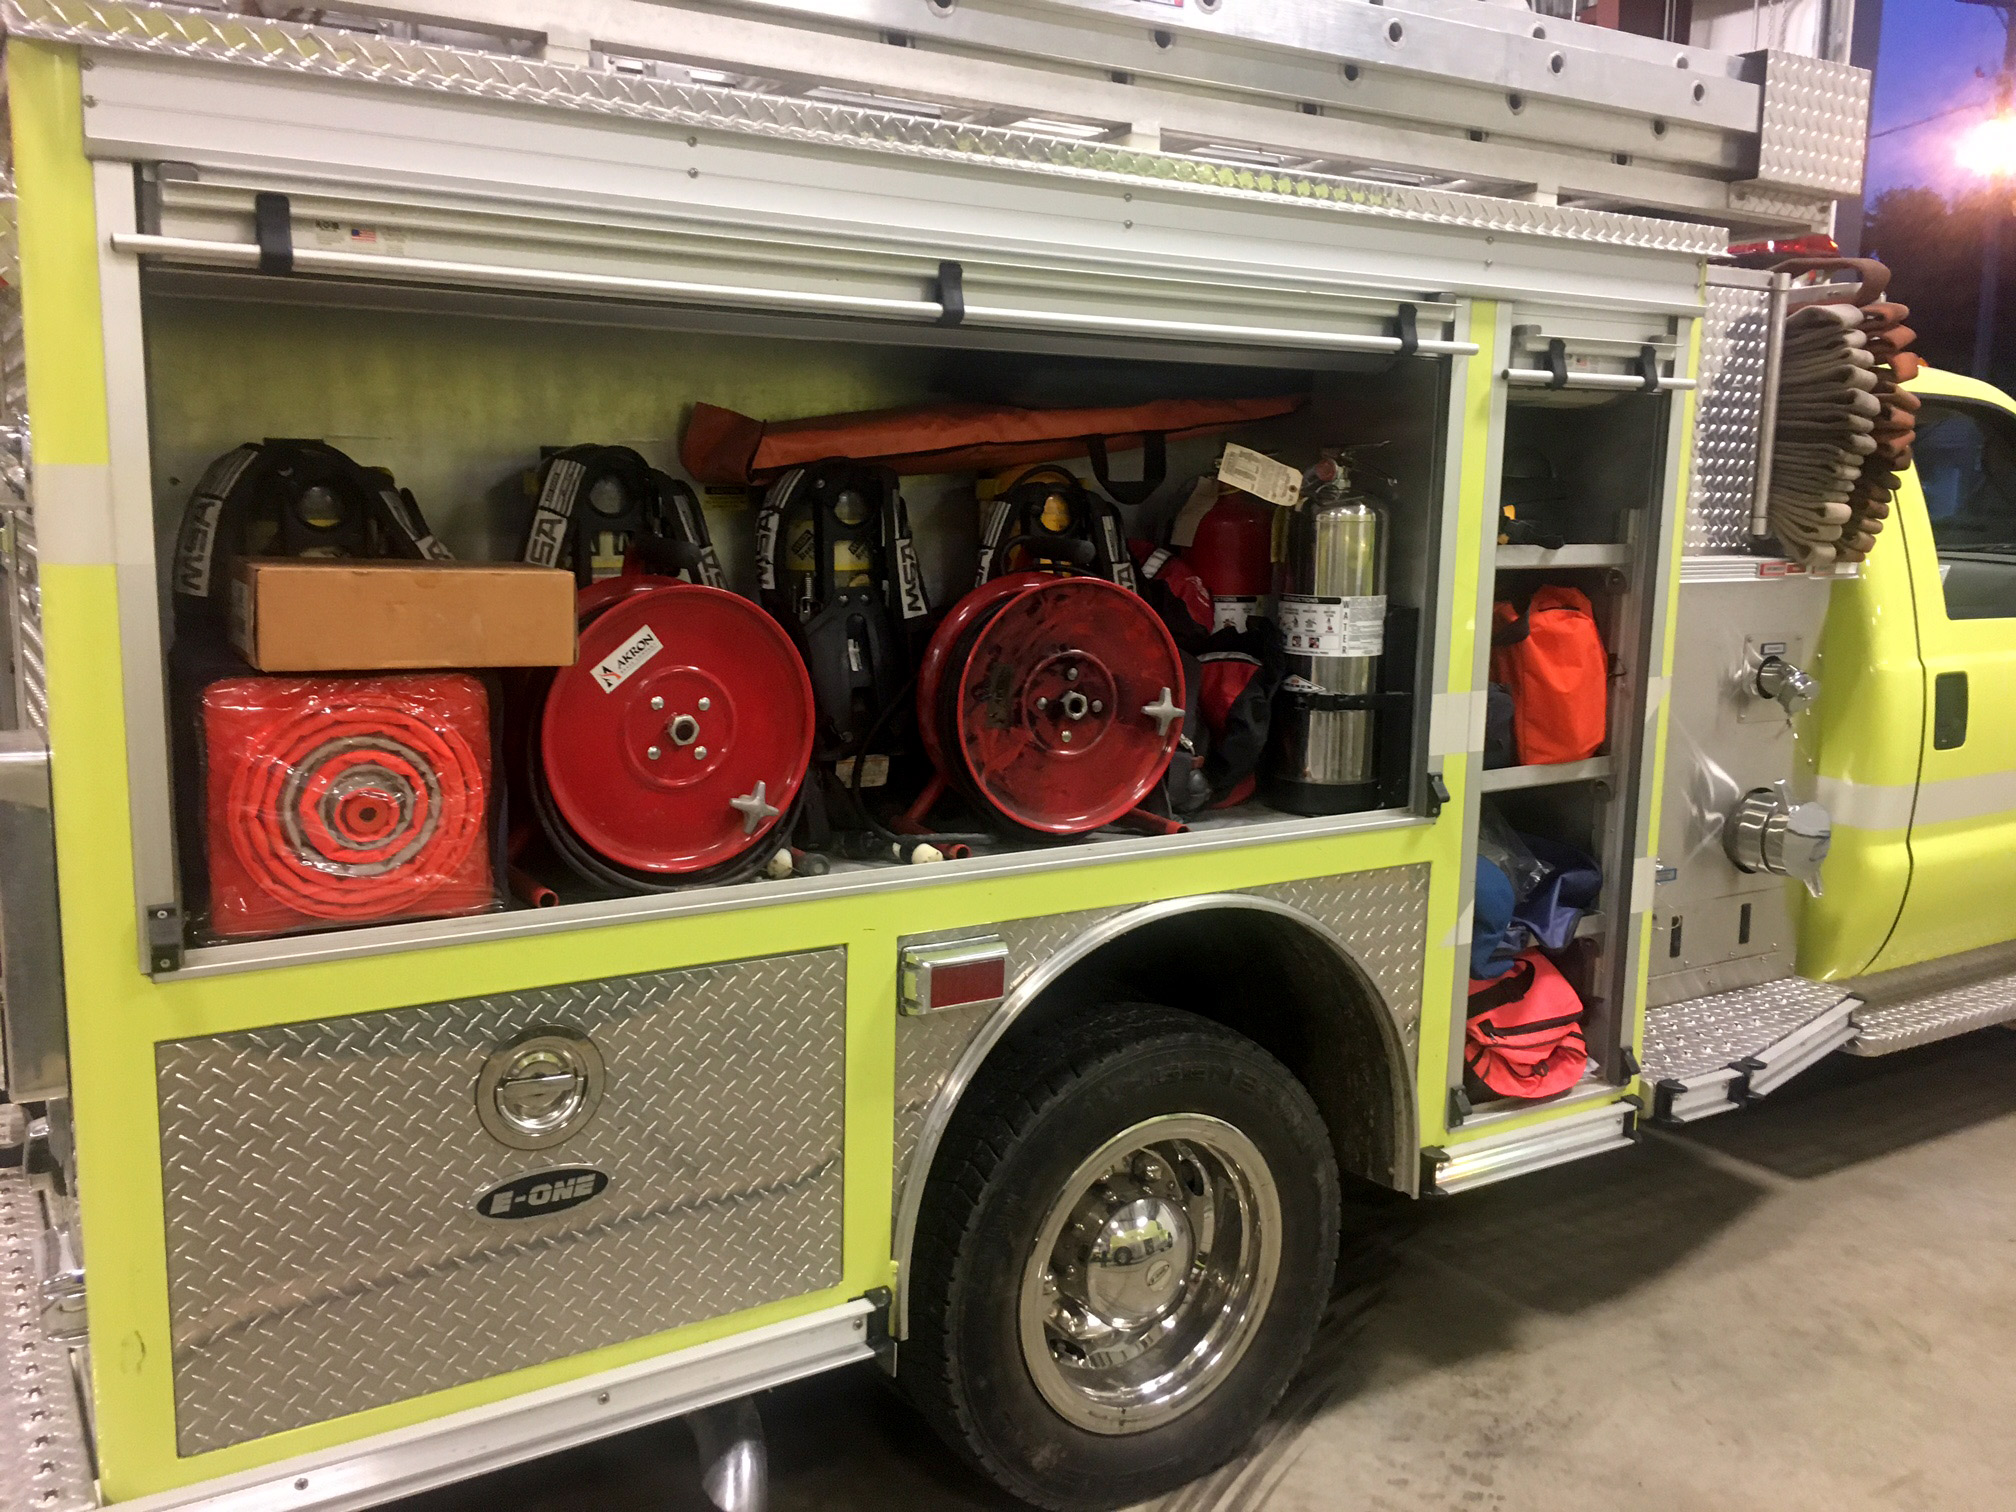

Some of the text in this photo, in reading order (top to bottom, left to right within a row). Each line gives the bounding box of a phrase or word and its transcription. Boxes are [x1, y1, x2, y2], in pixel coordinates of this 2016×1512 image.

[530, 518, 563, 566] SA
[900, 544, 923, 612] MSA
[617, 633, 654, 670] AKRON
[1341, 600, 1350, 655] WATER
[489, 1173, 597, 1215] E-ONE
